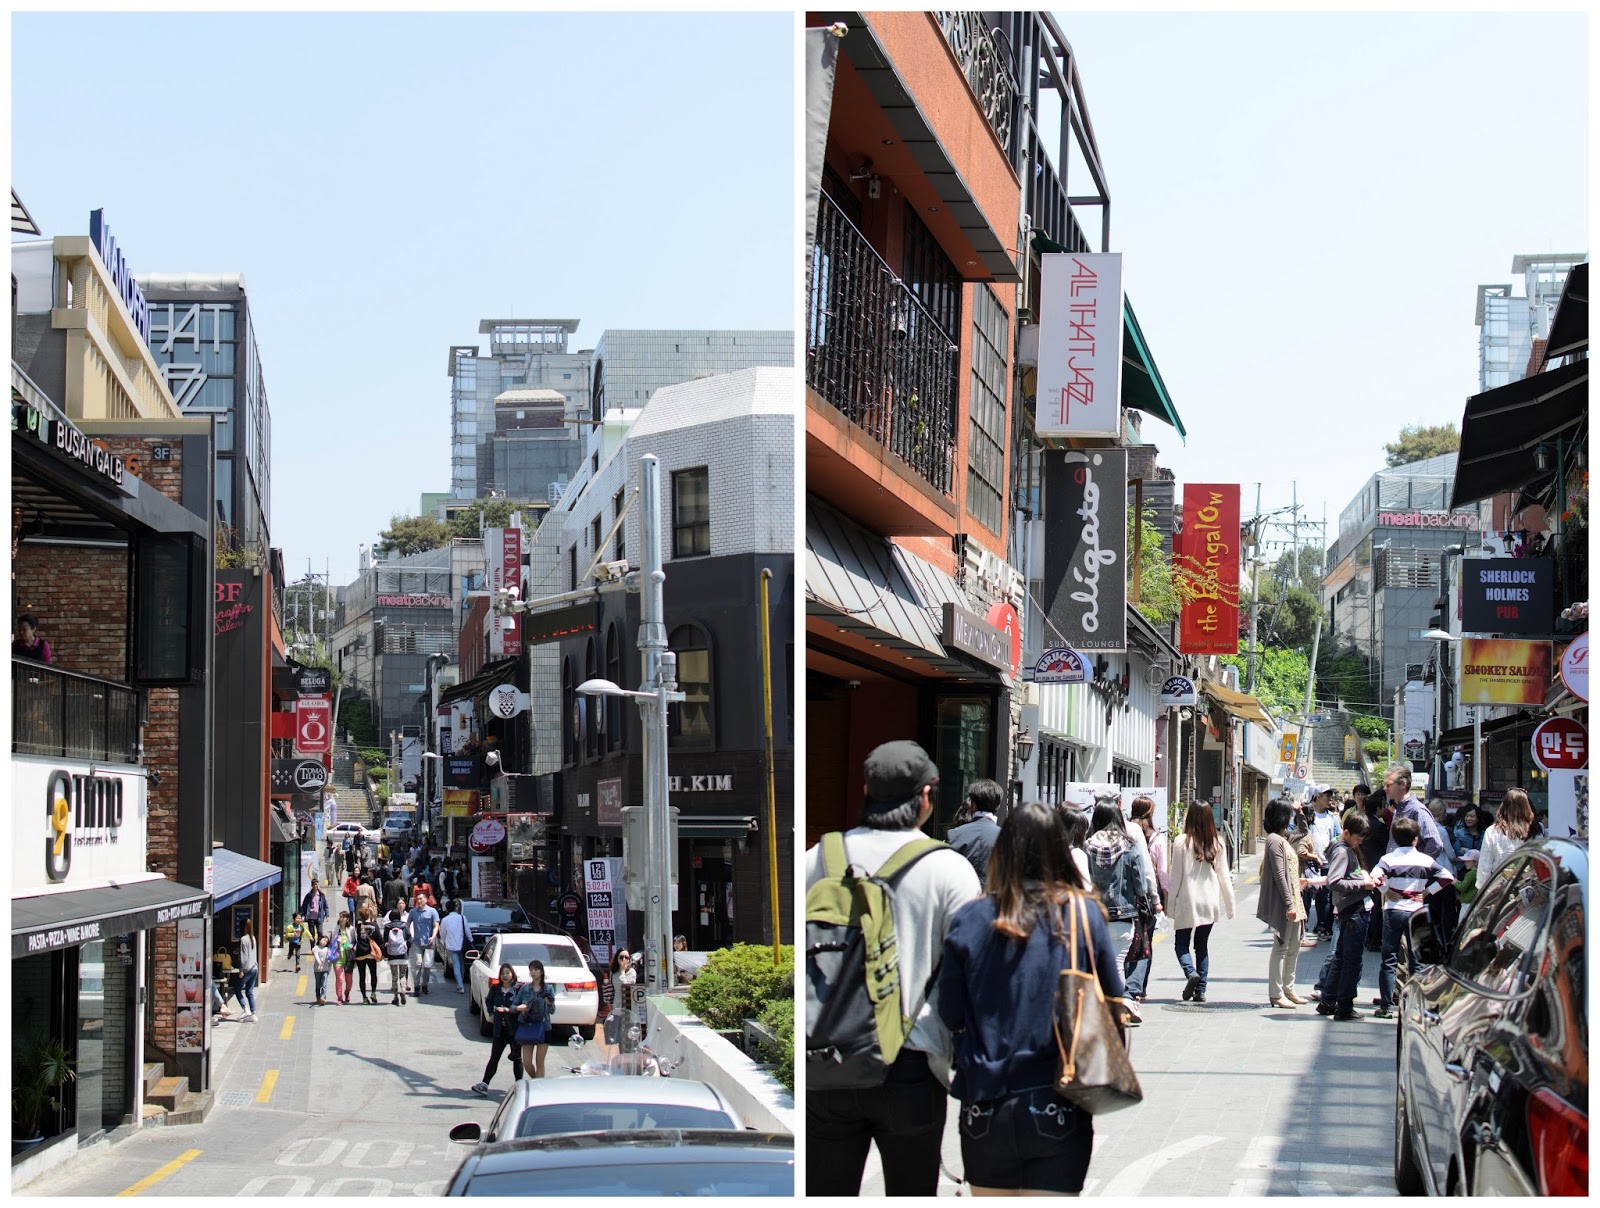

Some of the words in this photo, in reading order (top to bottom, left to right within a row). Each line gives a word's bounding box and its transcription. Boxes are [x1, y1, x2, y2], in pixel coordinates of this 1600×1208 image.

[1071, 258, 1097, 297] ALL
[1069, 299, 1096, 357] THAT
[56, 421, 93, 467] BUSAN
[96, 448, 125, 486] GALBI
[154, 447, 170, 460] 3F
[1379, 511, 1479, 531] meatpacking
[1480, 570, 1536, 583] SHERLOCK
[377, 594, 451, 609] meatpacking
[1486, 588, 1529, 601] HOLMES
[1197, 605, 1218, 632] the
[1496, 606, 1519, 619] PUB
[1039, 651, 1079, 671] BRUGAL
[1464, 665, 1508, 676] SMOKEY
[300, 677, 326, 685] BELUGA
[1164, 679, 1191, 691] BRUGAL
[1541, 732, 1585, 759] 만두
[588, 910, 612, 919] GRAND
[589, 920, 612, 928] OPEN!
[28, 933, 47, 951] PASTA
[48, 930, 65, 947] PIZZA
[66, 926, 80, 943] WINE
